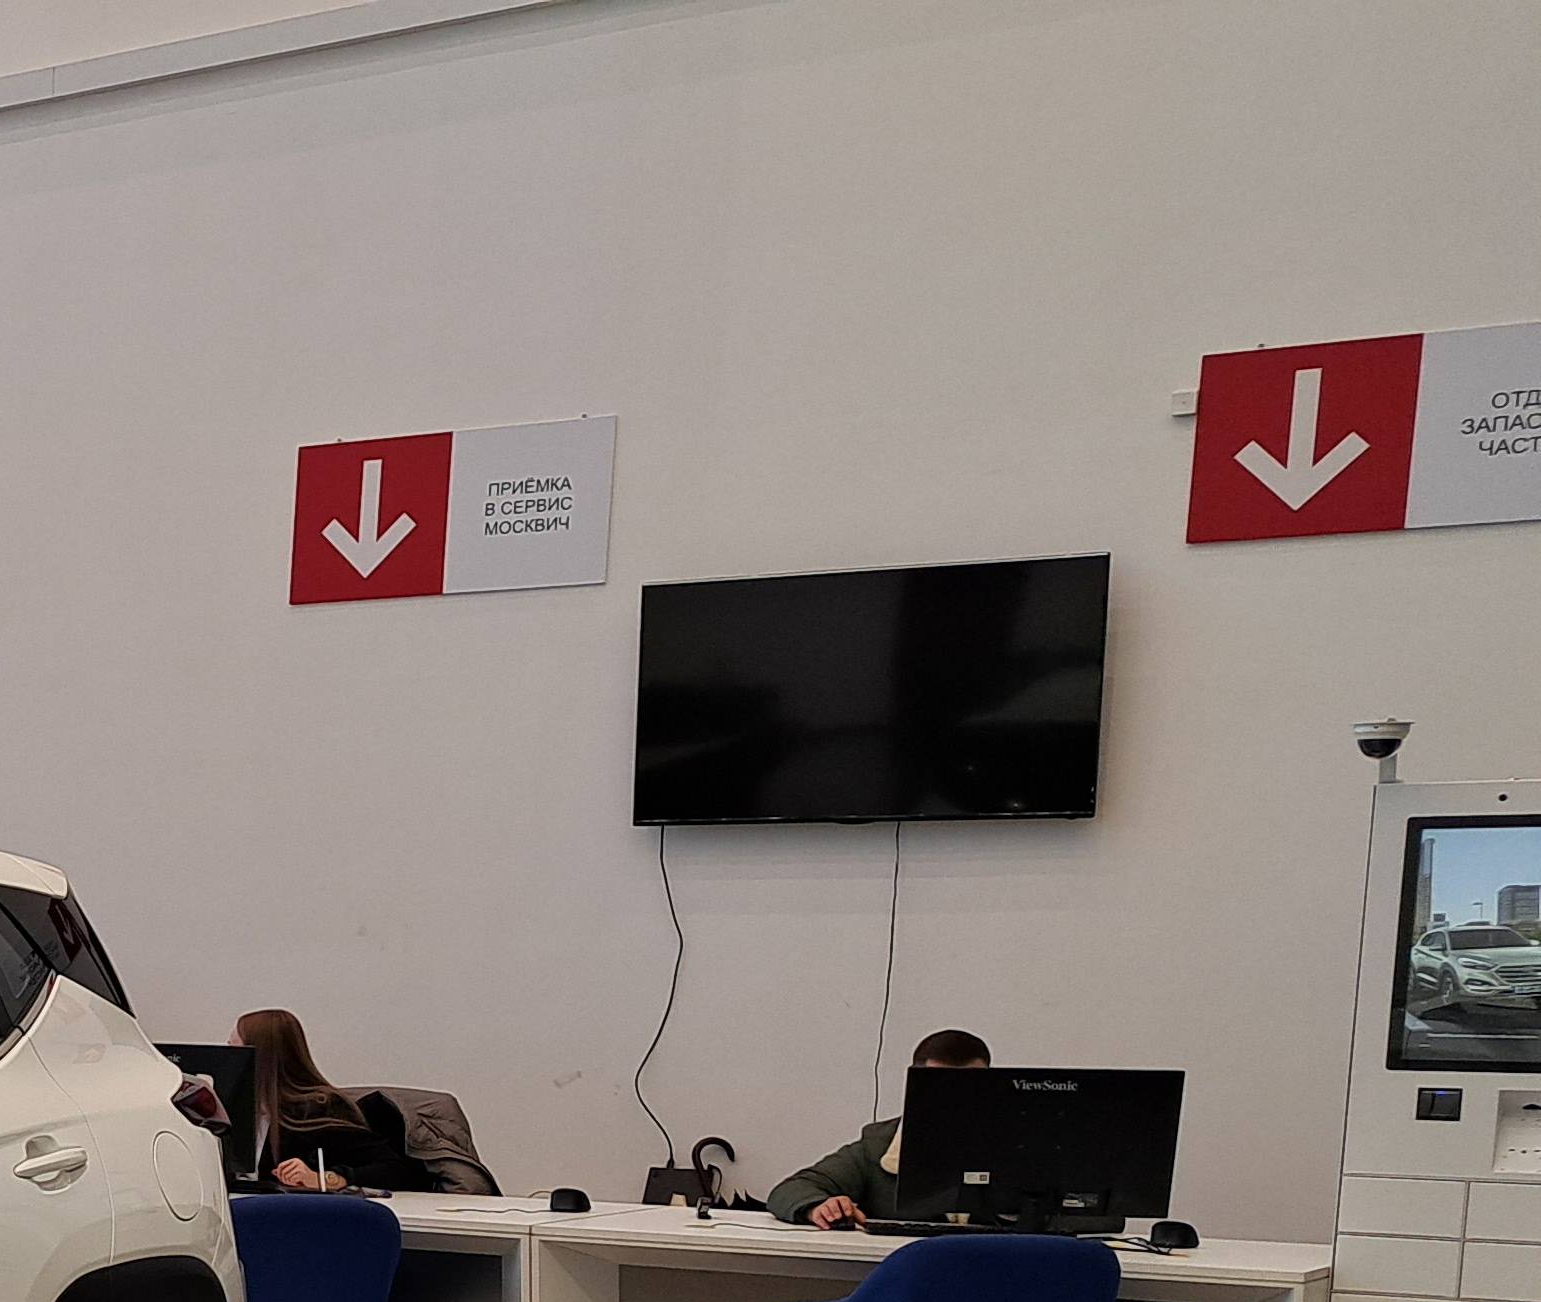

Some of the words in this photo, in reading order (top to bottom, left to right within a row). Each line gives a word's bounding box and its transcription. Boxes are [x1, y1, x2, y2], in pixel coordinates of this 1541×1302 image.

[488, 477, 572, 496] ПРИЁМКА
[485, 502, 496, 516] В
[500, 496, 573, 515] СЕРВИС
[484, 516, 570, 535] МОСКВИЧ
[1013, 1080, 1078, 1091] ViewSonic
